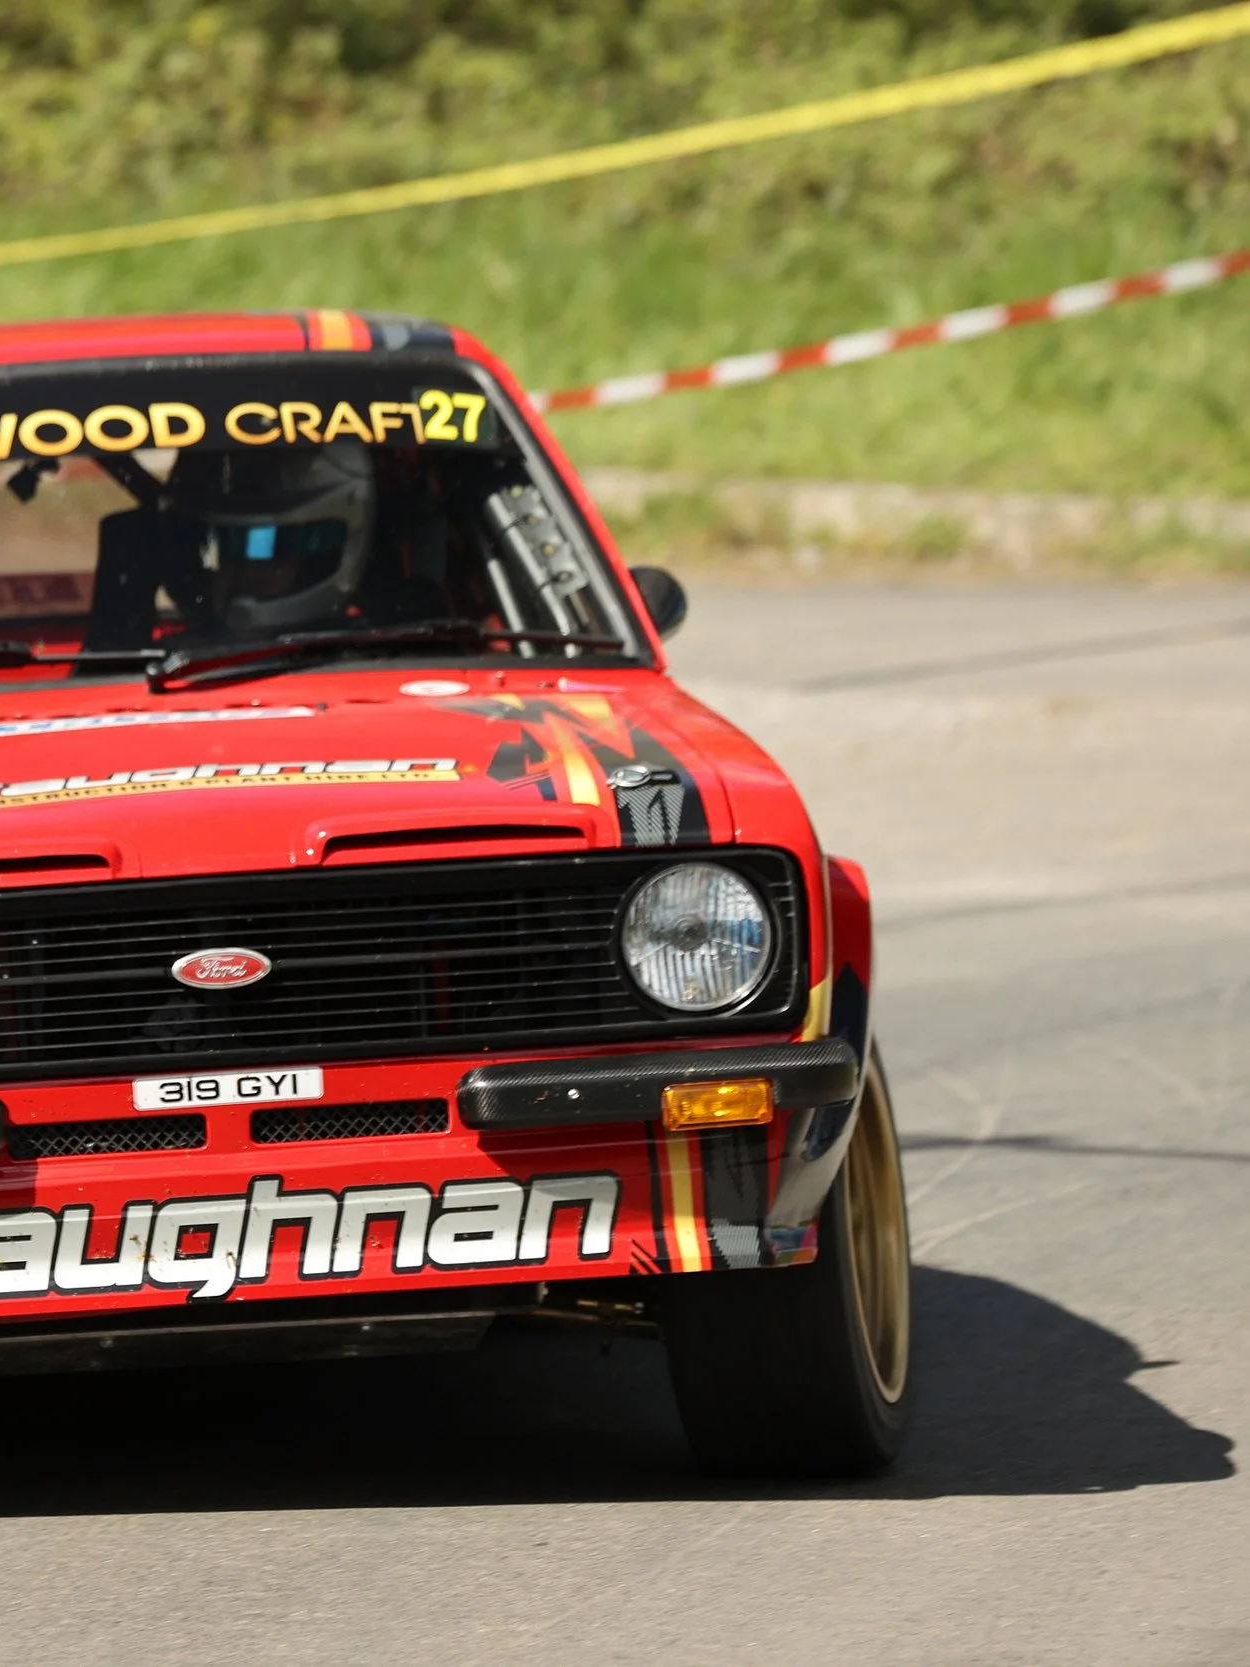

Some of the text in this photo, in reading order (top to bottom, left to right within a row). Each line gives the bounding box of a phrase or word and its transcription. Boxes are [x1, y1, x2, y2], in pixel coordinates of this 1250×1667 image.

[224, 400, 427, 445] CRAFT
[419, 389, 487, 443] 27
[195, 956, 249, 979] Ford
[159, 1079, 221, 1103] 319
